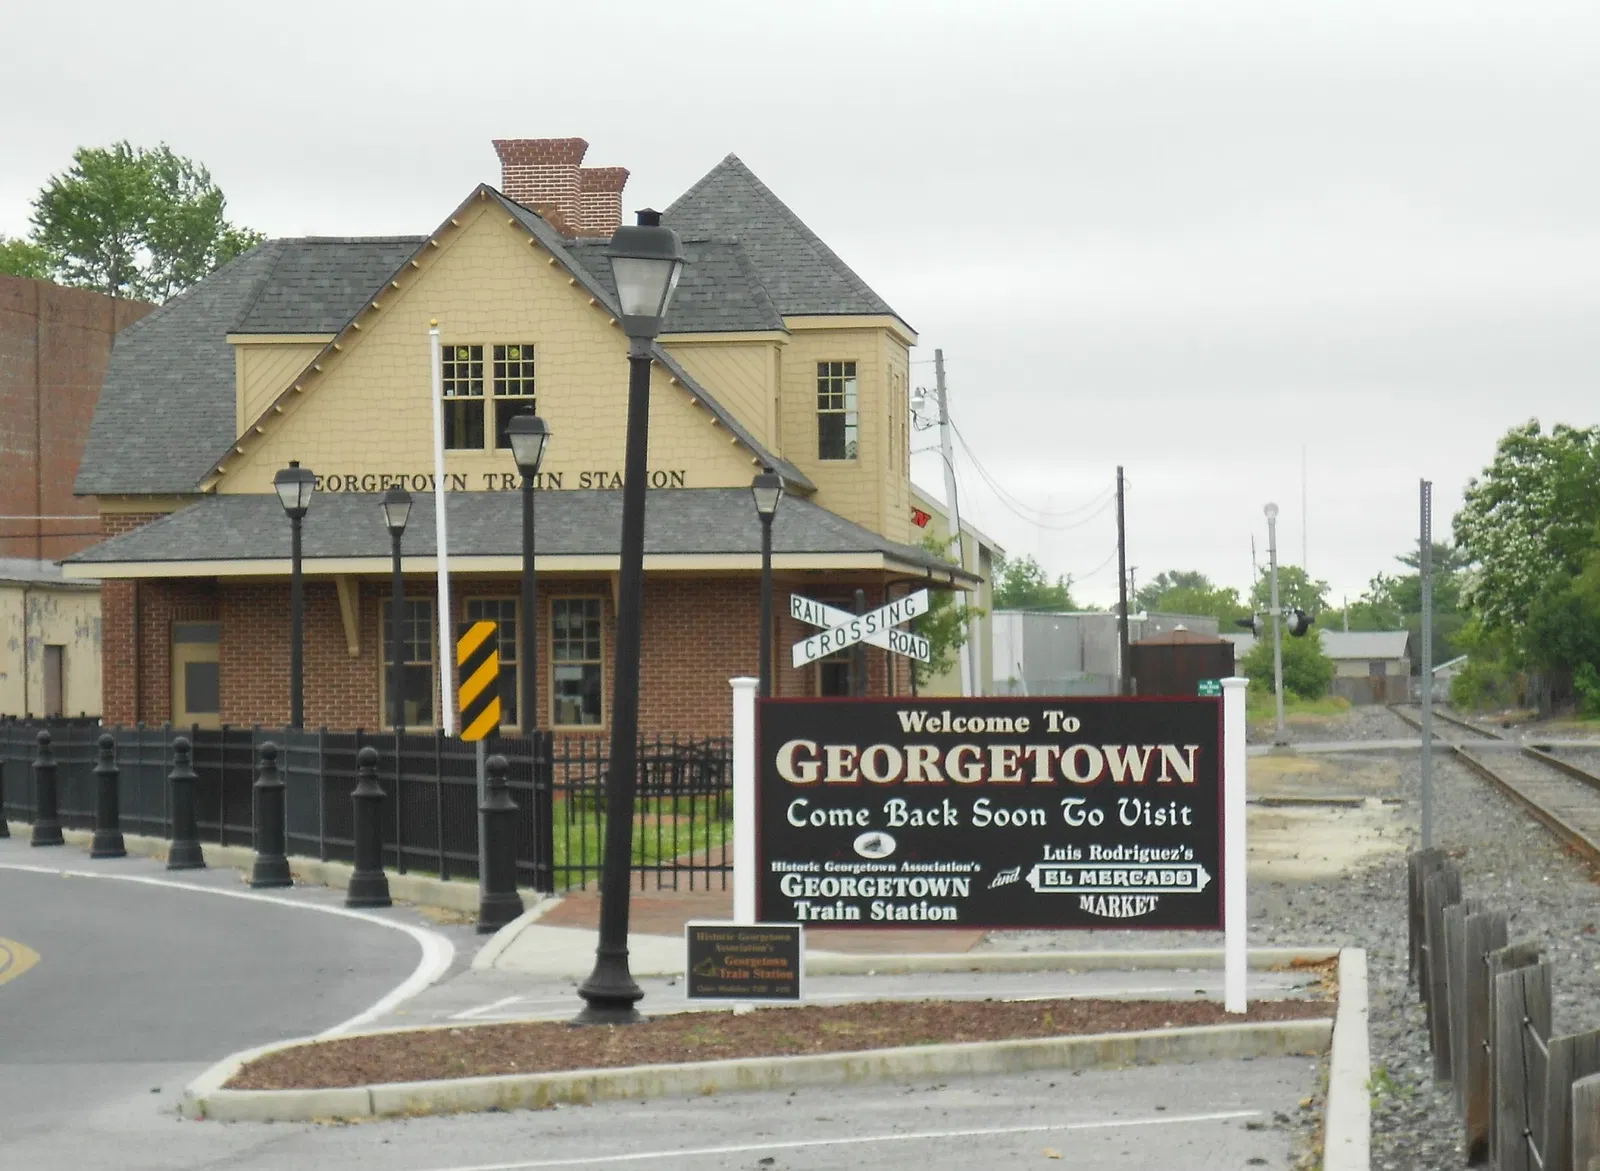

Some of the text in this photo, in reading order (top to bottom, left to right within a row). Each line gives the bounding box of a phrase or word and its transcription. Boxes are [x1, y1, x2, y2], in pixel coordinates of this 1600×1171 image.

[313, 470, 686, 492] EORGETOWN TRIN STAON
[792, 597, 928, 660] RAIL ROAD
[805, 597, 916, 660] CROSSING
[896, 709, 1081, 734] Welcome To
[775, 738, 1201, 787] GEORGETOWN
[786, 797, 1193, 828] Come Back Soon To Visit
[1042, 844, 1195, 863] Luis Rodriguez's
[771, 860, 982, 875] Historic Georgetown Association's
[991, 865, 1021, 889] and
[1044, 869, 1193, 887] EL MERCADO
[779, 873, 971, 898] GEORGETOWN
[793, 900, 958, 922] Train Station
[1079, 894, 1159, 918] MARKET
